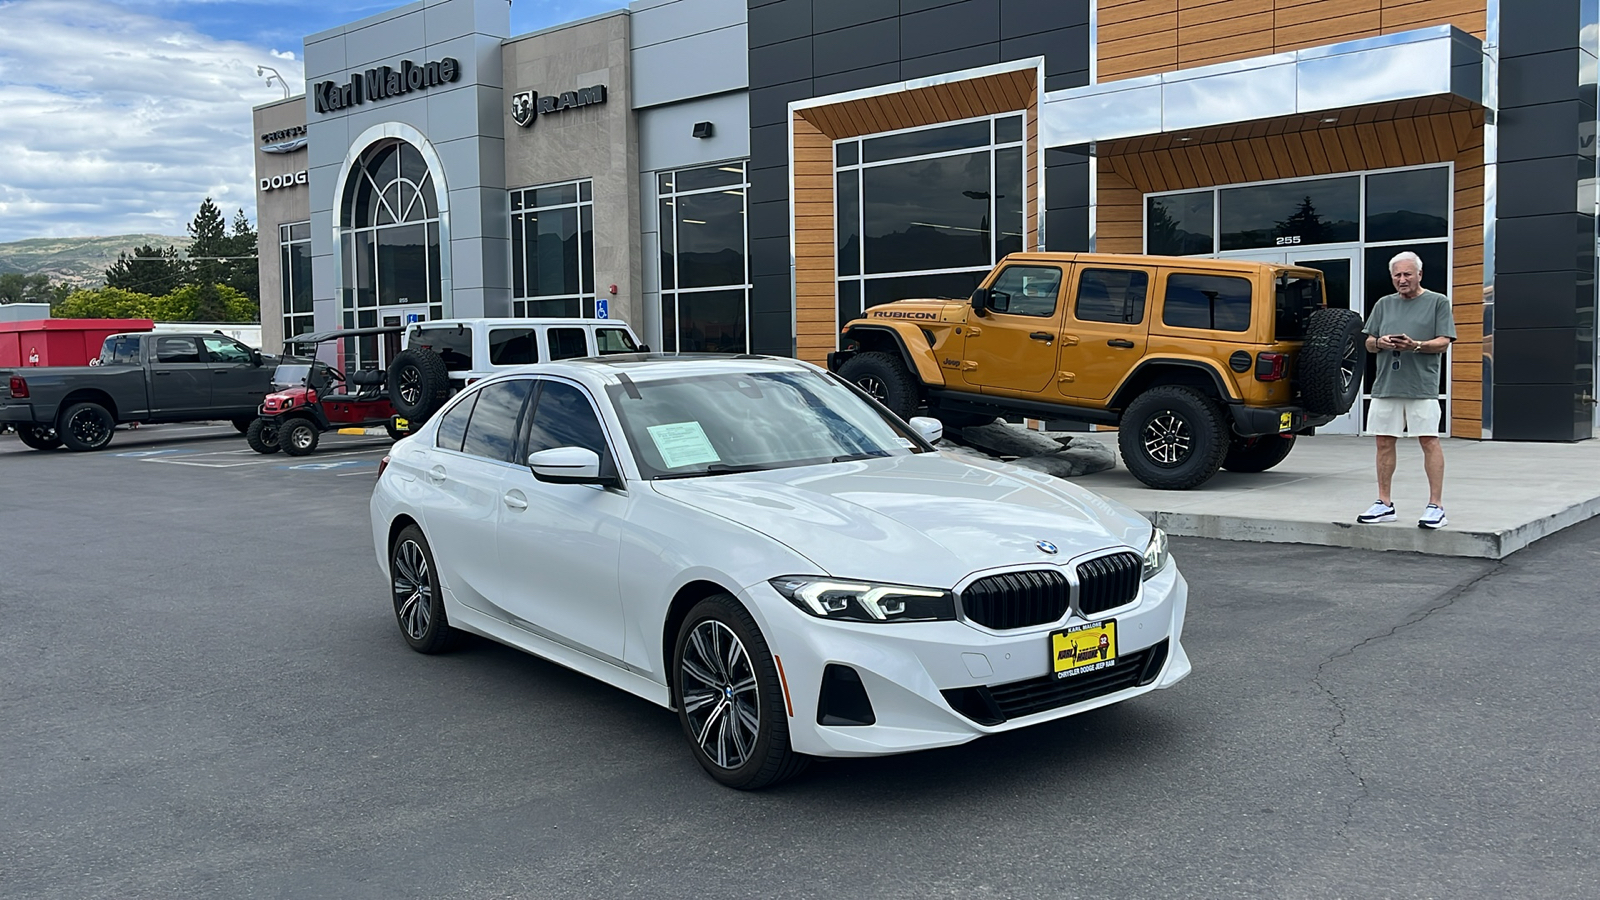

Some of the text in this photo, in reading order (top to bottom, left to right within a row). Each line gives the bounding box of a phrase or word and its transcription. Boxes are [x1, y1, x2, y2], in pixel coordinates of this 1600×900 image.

[313, 57, 459, 113] Karl Malone
[538, 84, 607, 115] RAM
[260, 170, 309, 192] DODG
[1276, 235, 1301, 245] 255
[873, 311, 937, 320] RUBICON
[943, 358, 961, 367] Jeep
[1082, 621, 1102, 631] MALONE
[1057, 659, 1115, 680] CHRYSLER DODGE JEEP RAM
